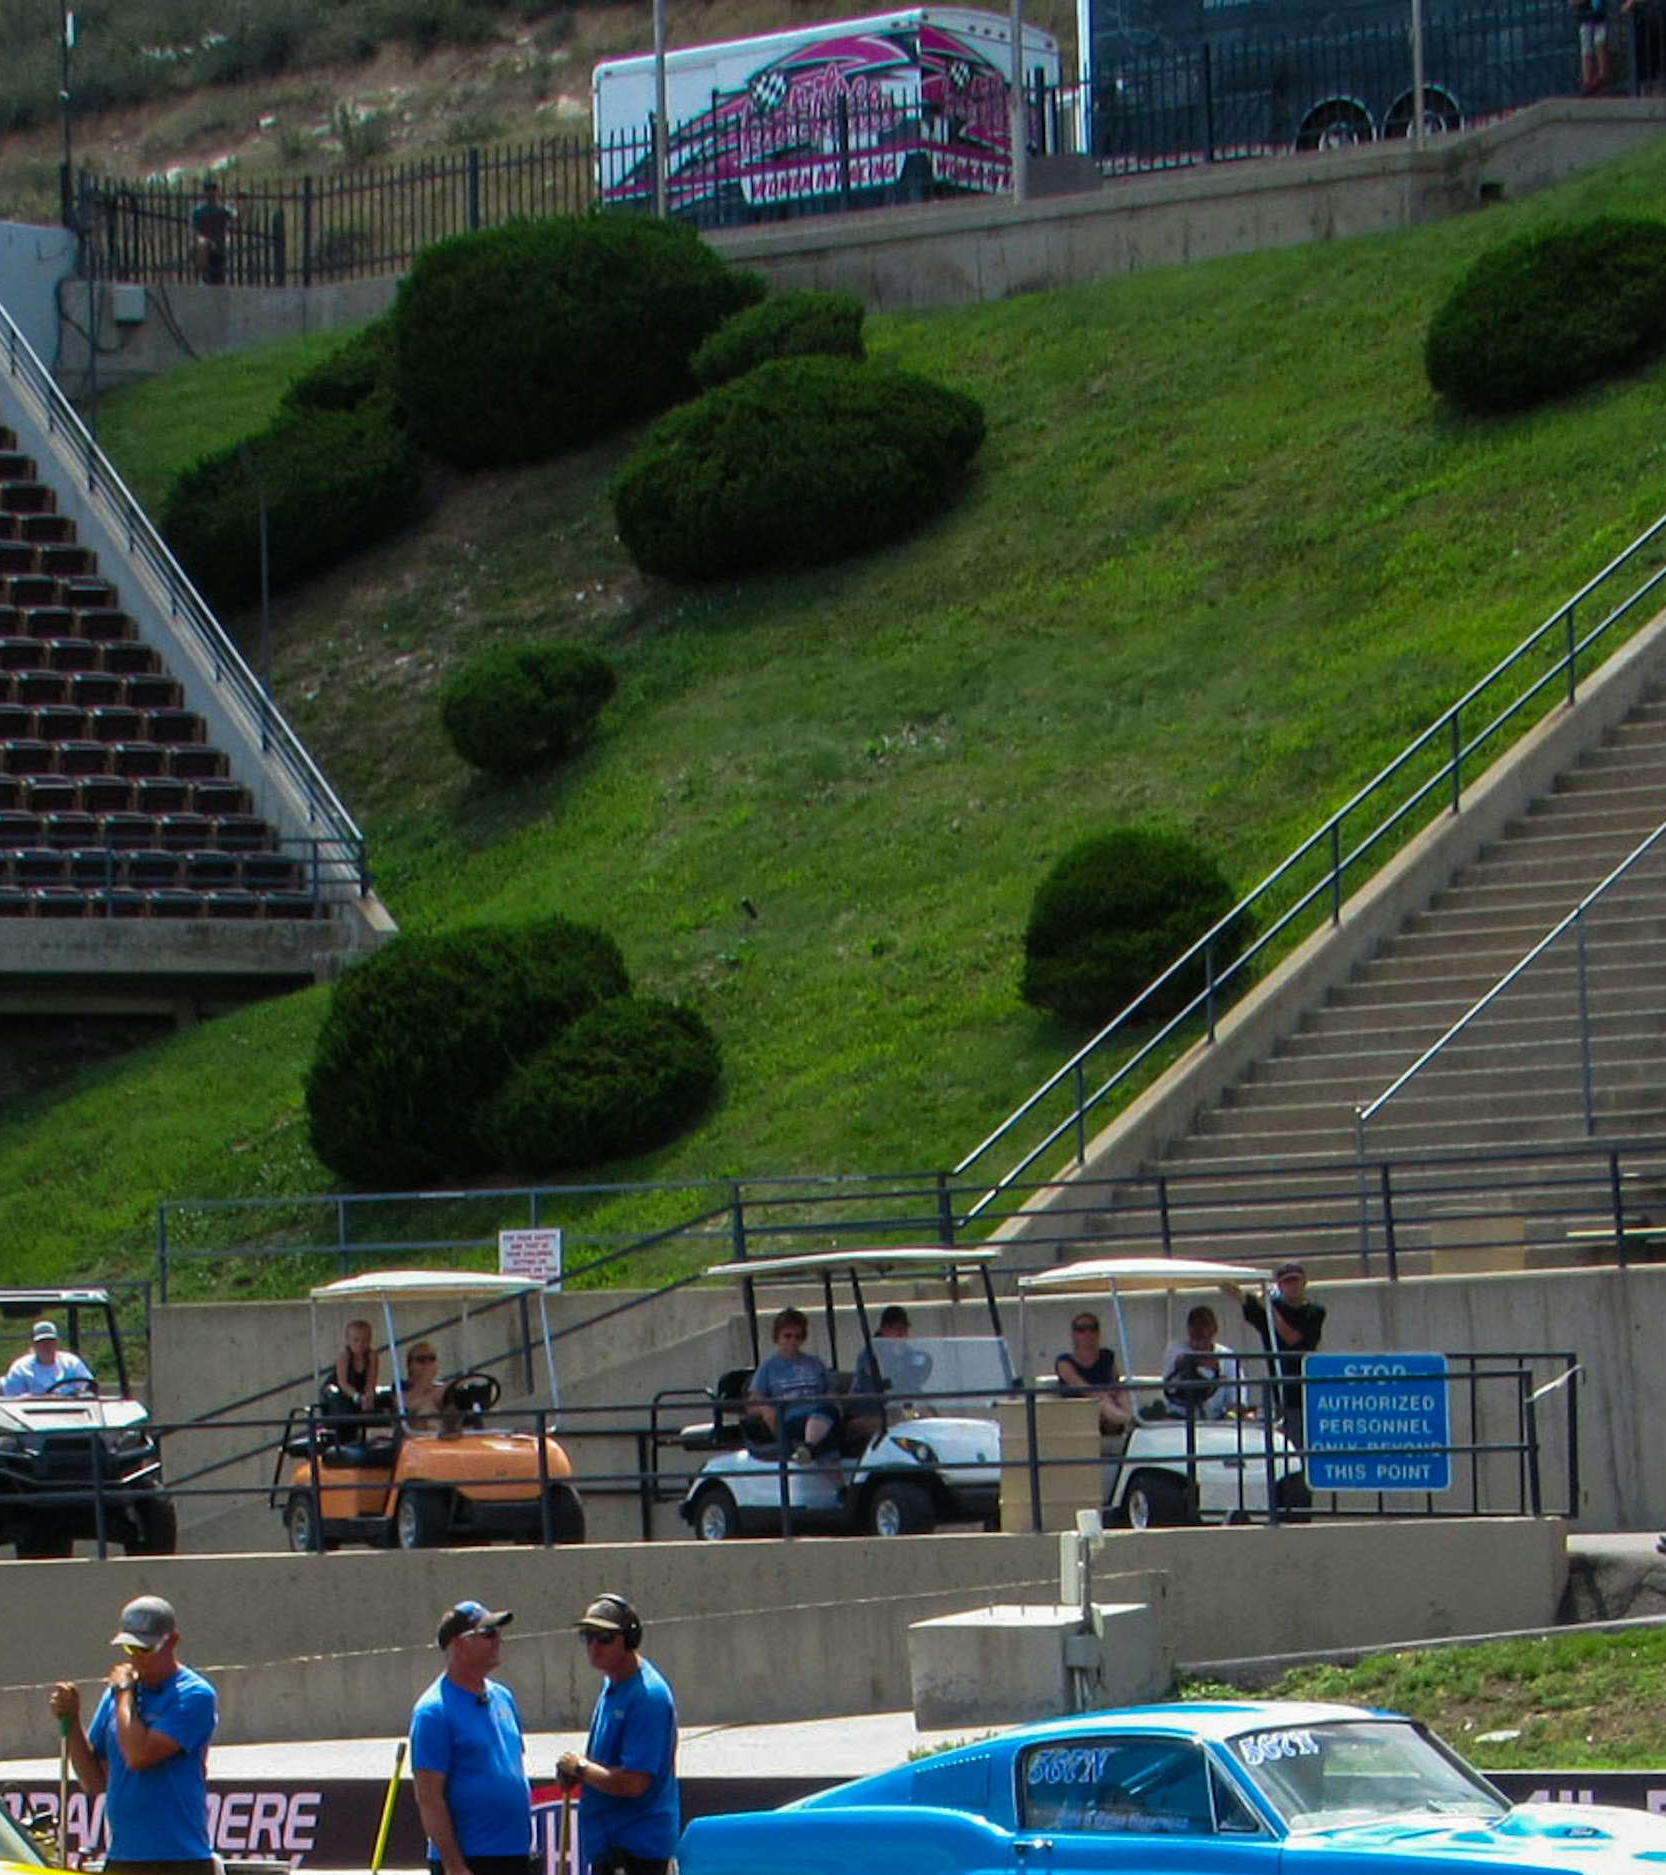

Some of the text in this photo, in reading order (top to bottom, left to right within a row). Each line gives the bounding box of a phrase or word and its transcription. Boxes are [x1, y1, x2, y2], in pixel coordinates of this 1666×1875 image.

[1317, 1395, 1435, 1412] AUTHORIZED
[1318, 1419, 1433, 1435] PERSONNEL
[1324, 1464, 1432, 1480] THIS POINT
